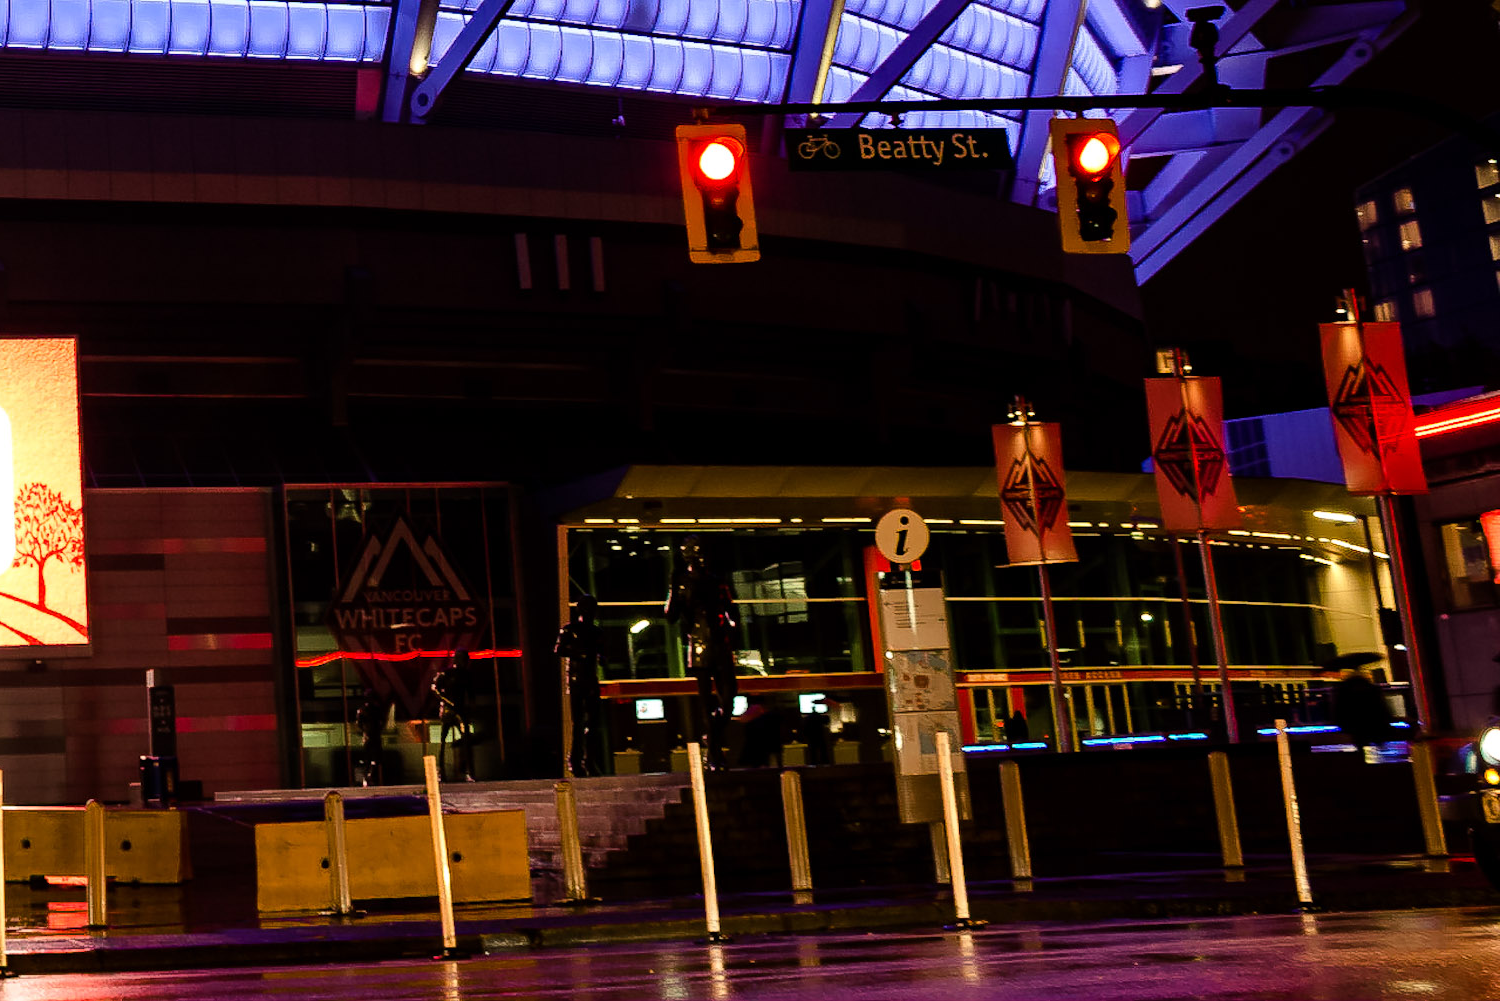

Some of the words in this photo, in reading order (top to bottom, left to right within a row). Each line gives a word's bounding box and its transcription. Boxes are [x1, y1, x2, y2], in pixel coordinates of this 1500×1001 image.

[857, 133, 945, 167] Beatty
[951, 132, 989, 160] St.
[334, 606, 477, 630] WHITECAPS
[394, 633, 423, 653] FC
